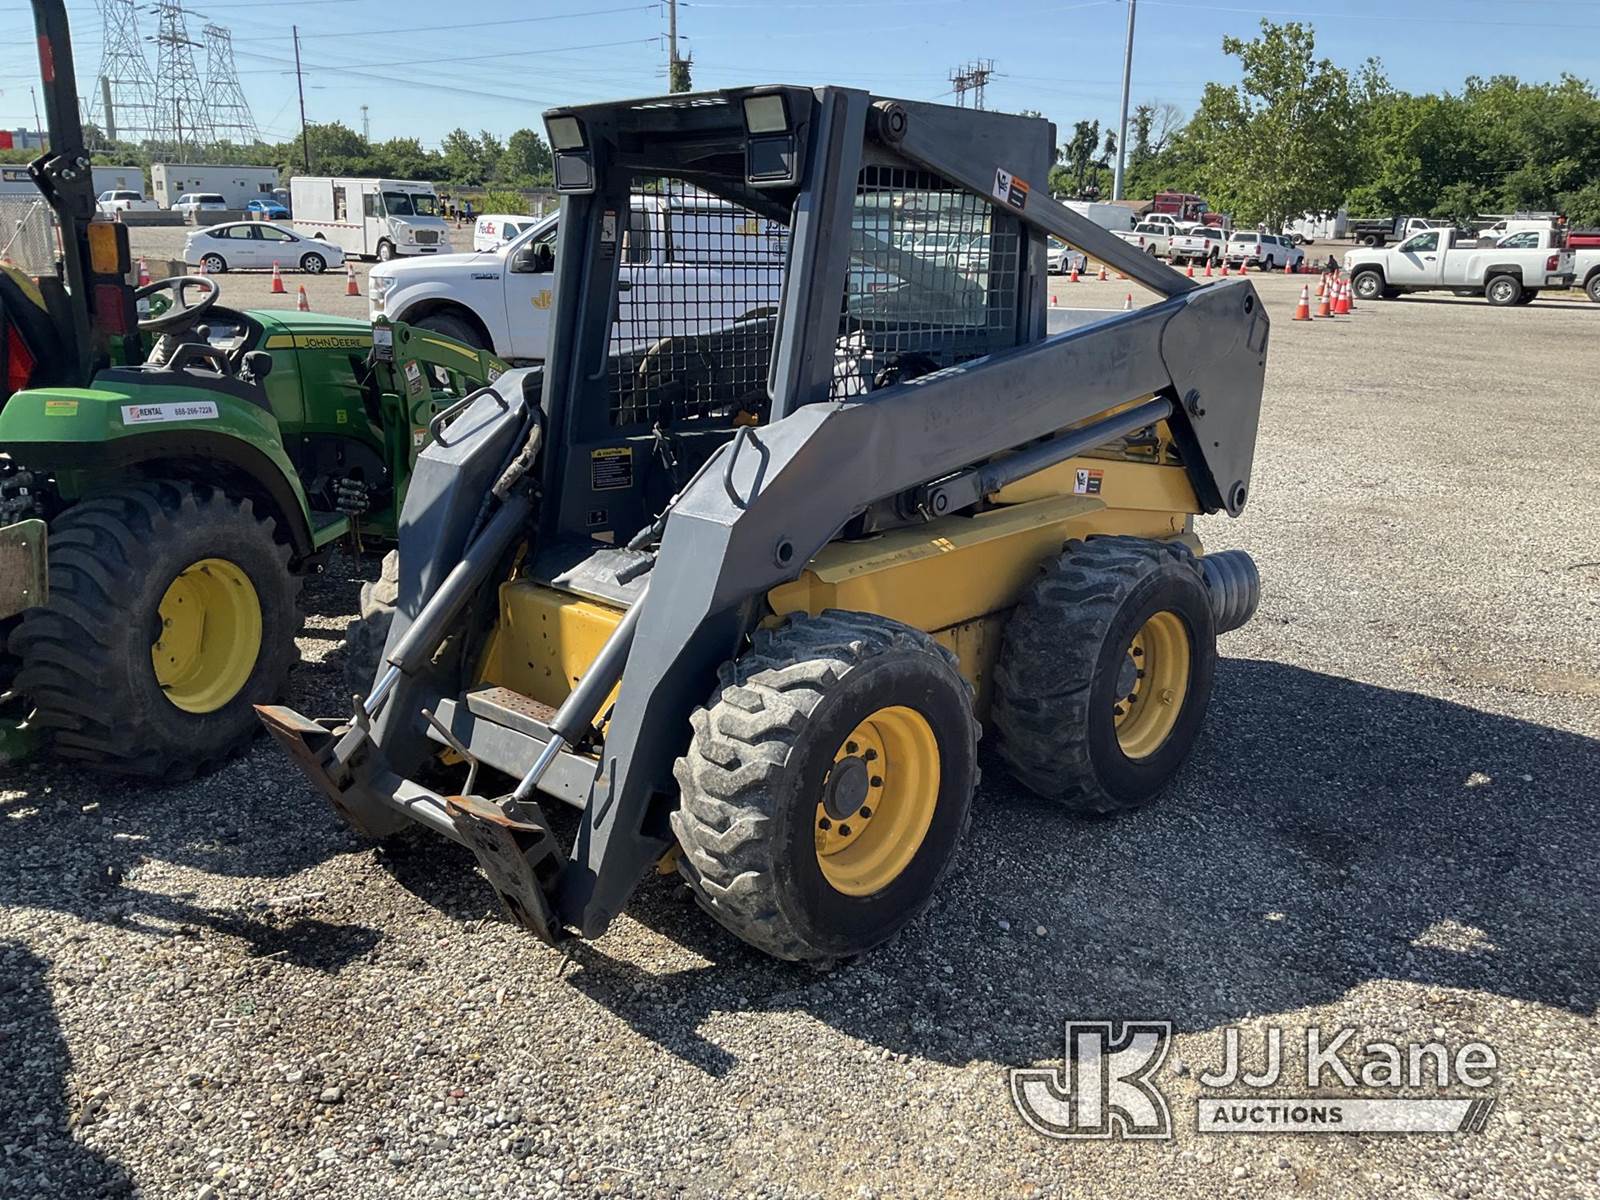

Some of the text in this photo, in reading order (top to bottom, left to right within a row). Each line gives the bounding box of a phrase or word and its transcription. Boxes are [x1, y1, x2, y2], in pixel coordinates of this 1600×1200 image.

[478, 222, 496, 235] FedEx
[304, 337, 361, 347] JOHN DEERE
[139, 407, 162, 416] RENTAL
